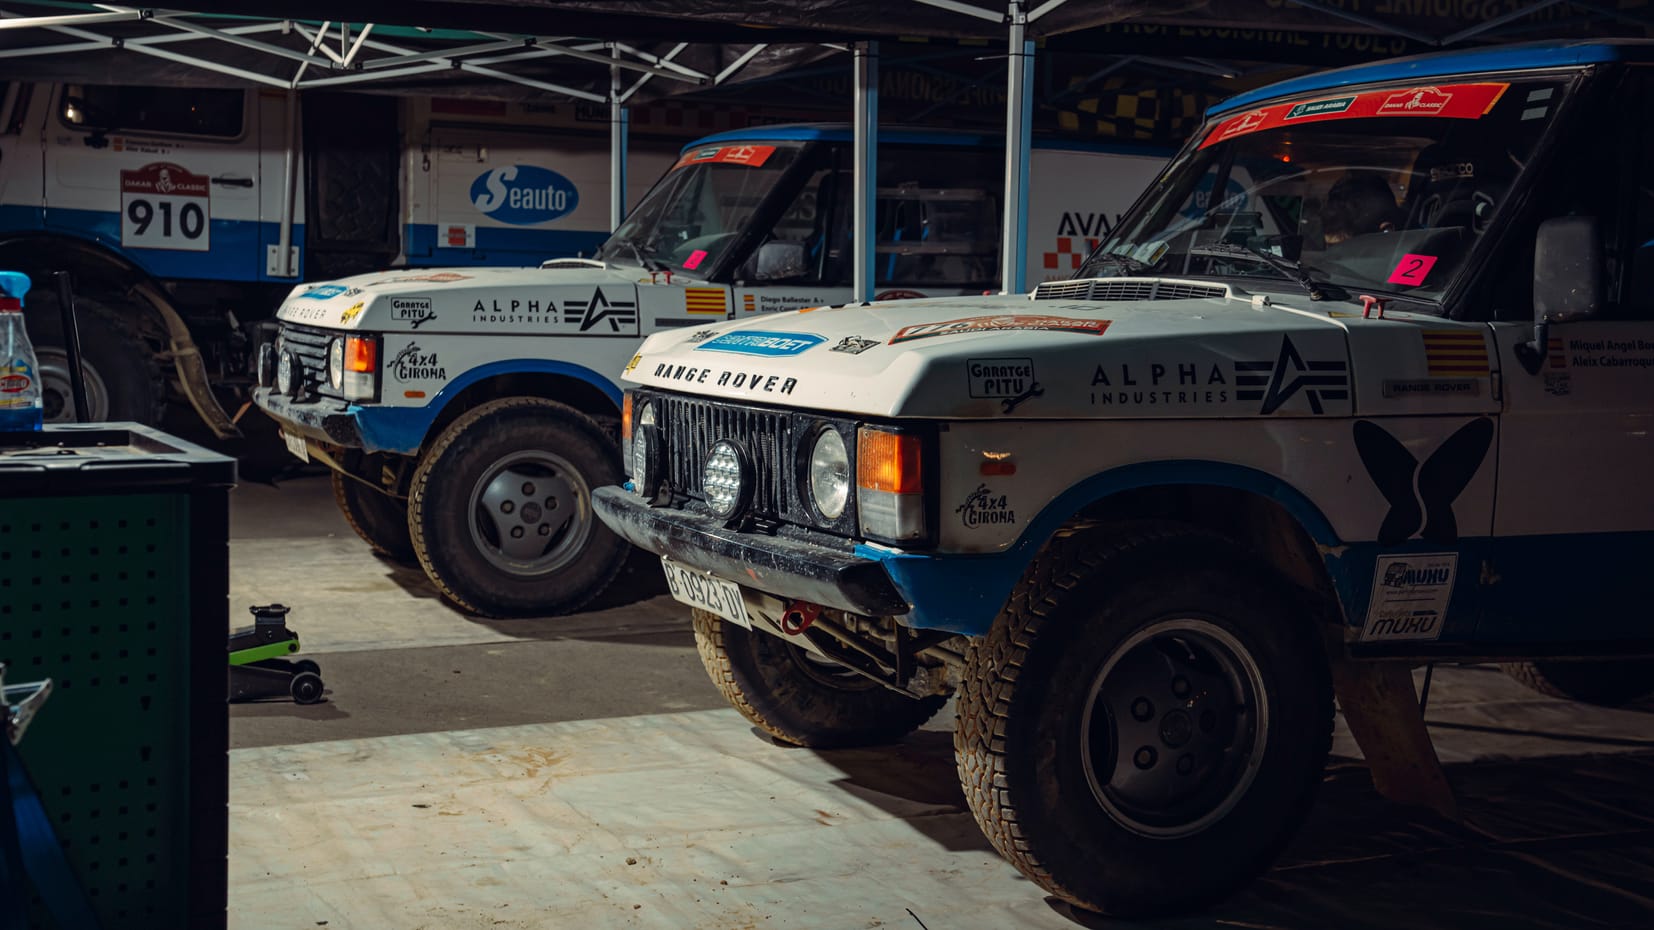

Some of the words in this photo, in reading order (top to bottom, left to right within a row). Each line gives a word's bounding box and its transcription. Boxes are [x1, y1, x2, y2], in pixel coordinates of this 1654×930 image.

[474, 165, 567, 214] Seauto
[127, 199, 205, 240] 910
[1401, 258, 1424, 278] 2
[400, 309, 425, 319] PITU
[473, 300, 558, 313] ALPHA
[473, 315, 559, 324] INDUSTRIES
[1607, 340, 1636, 352] Angel
[399, 366, 447, 381] GIRONA
[970, 363, 1031, 377] GARATGE
[1091, 363, 1226, 386] ALPHA
[654, 363, 711, 384] RANGE
[717, 371, 798, 395] ROVER
[984, 378, 1024, 394] PITU
[1392, 383, 1430, 393] RANGE
[1434, 382, 1471, 392] ROVER
[1091, 391, 1228, 404] INDUSTRIES
[968, 510, 1015, 525] GIRONA
